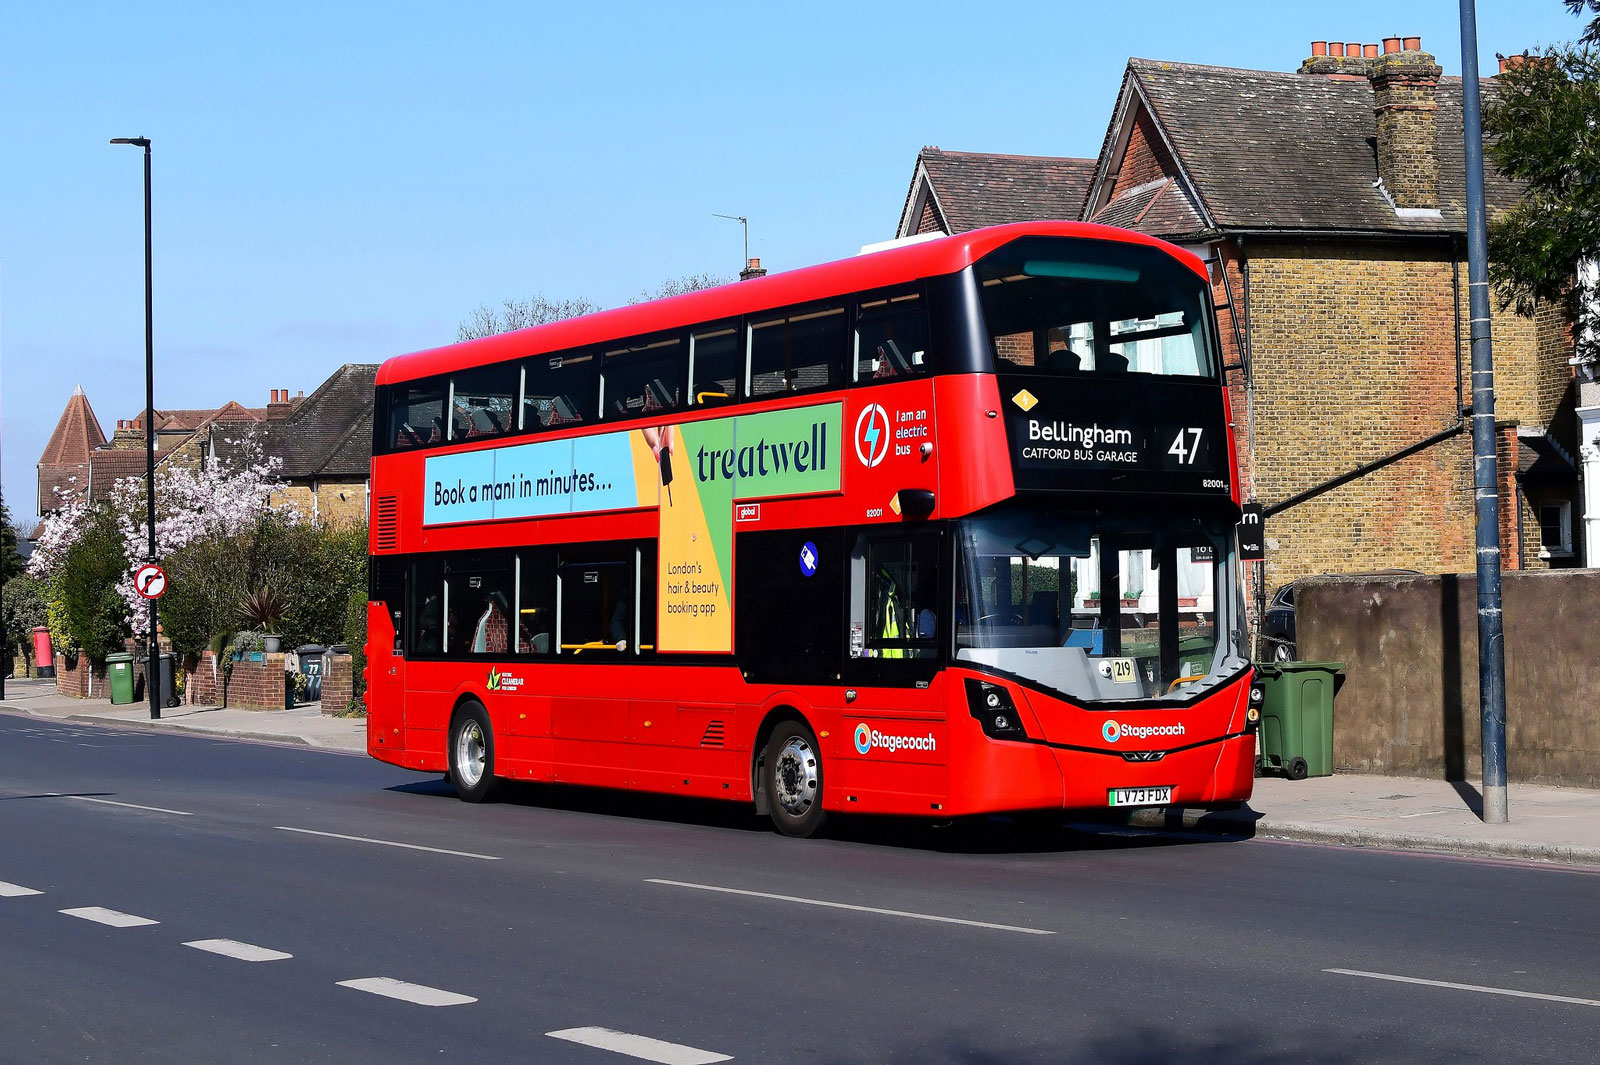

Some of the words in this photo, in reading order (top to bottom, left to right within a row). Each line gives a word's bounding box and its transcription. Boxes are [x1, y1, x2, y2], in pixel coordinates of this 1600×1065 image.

[896, 410, 899, 423] I
[901, 411, 914, 422] am
[916, 410, 927, 420] an
[896, 424, 928, 439] electric
[1029, 419, 1132, 449] Bellingham
[697, 422, 826, 482] treatwell
[896, 443, 911, 456] bus
[1167, 427, 1203, 465] 47
[1022, 447, 1071, 460] CATFORD
[1073, 449, 1094, 461] BUS
[1096, 450, 1138, 463] GARAGE
[434, 478, 465, 506] Book
[469, 485, 477, 503] a
[481, 474, 515, 501] mani
[519, 473, 532, 498] in
[536, 469, 612, 497] minutes...
[1202, 479, 1224, 488] 82001
[740, 507, 756, 518] global
[866, 508, 883, 518] 82001
[667, 560, 702, 575] London's
[667, 581, 683, 594] hair
[684, 580, 690, 594] &
[691, 580, 720, 597] beauty
[667, 600, 698, 617] booking
[699, 603, 716, 617] app
[1115, 661, 1131, 676] 219
[307, 674, 322, 689] 77
[1120, 722, 1185, 739] Stagecoach
[871, 729, 936, 753] Stagecoach
[1116, 789, 1145, 804] LV73
[1147, 788, 1169, 802] FDX
